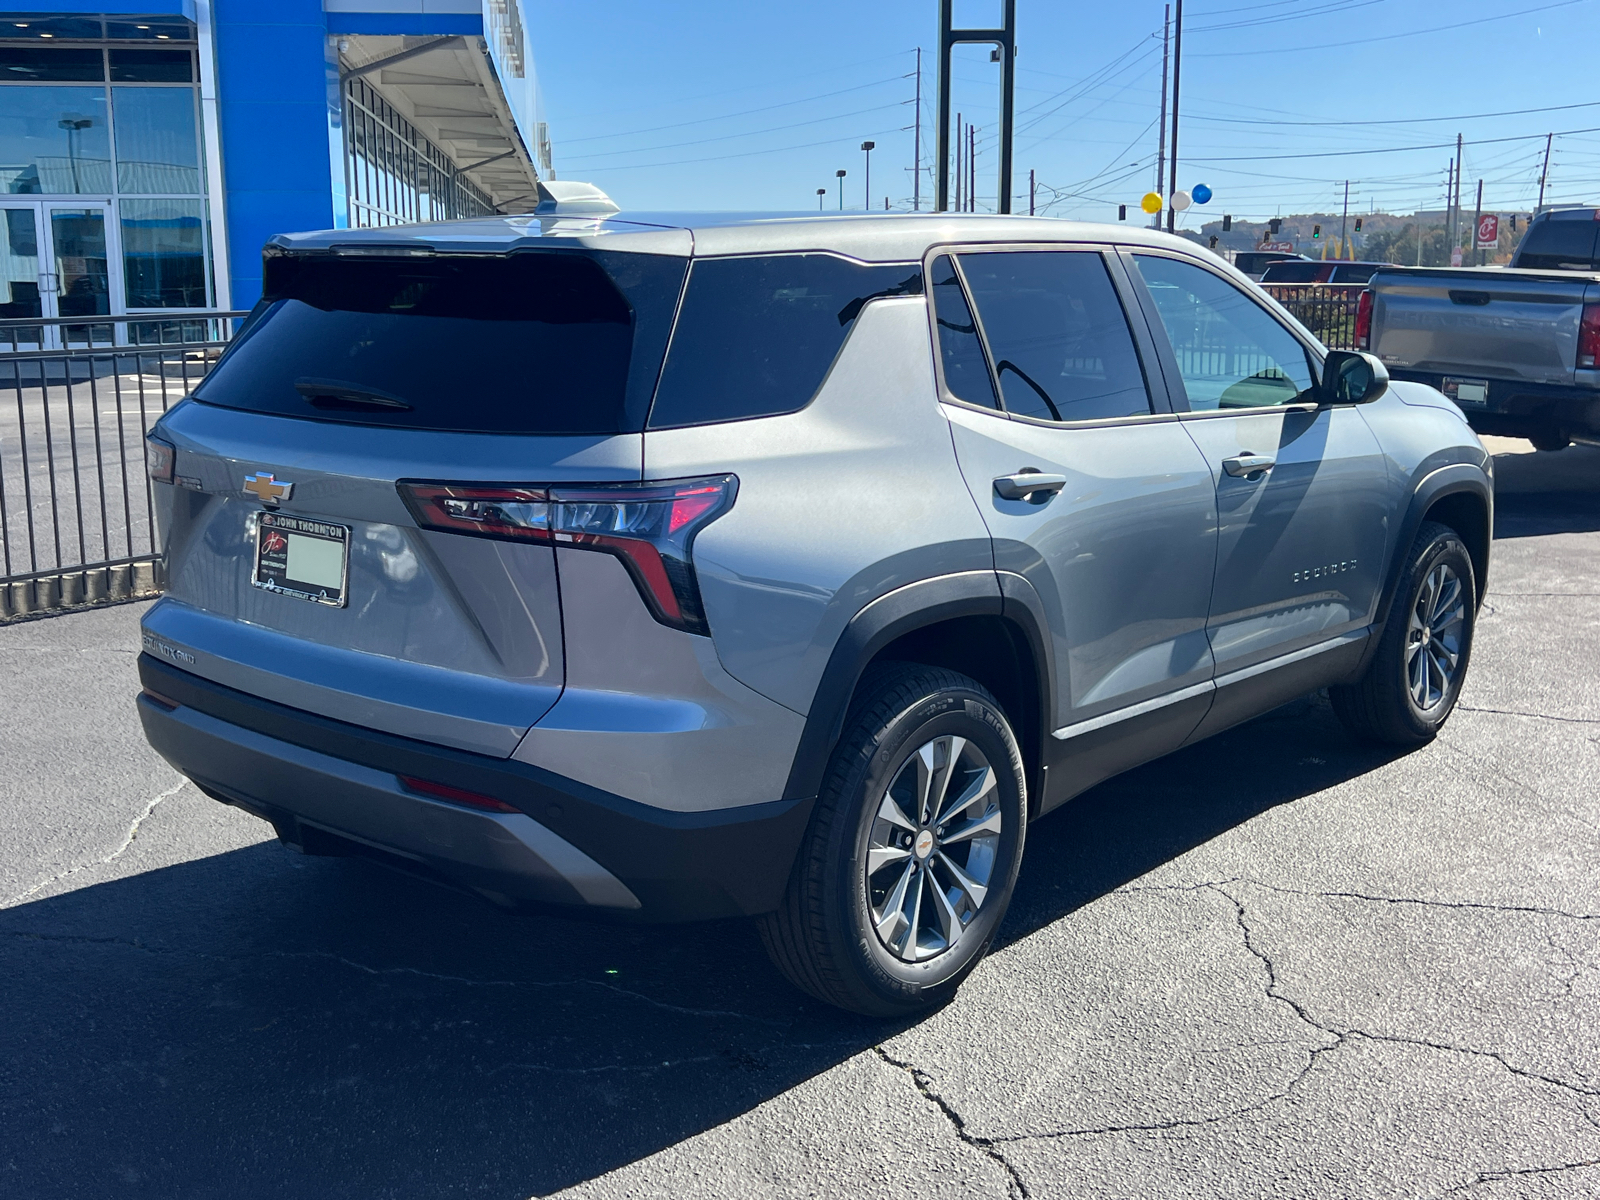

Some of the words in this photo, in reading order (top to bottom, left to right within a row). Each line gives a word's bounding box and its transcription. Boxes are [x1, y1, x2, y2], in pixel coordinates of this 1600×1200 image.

[276, 516, 297, 529] JOHN
[298, 520, 342, 538] THORNTON
[1292, 559, 1358, 583] EQUINOX
[142, 634, 178, 661] EQUINOX
